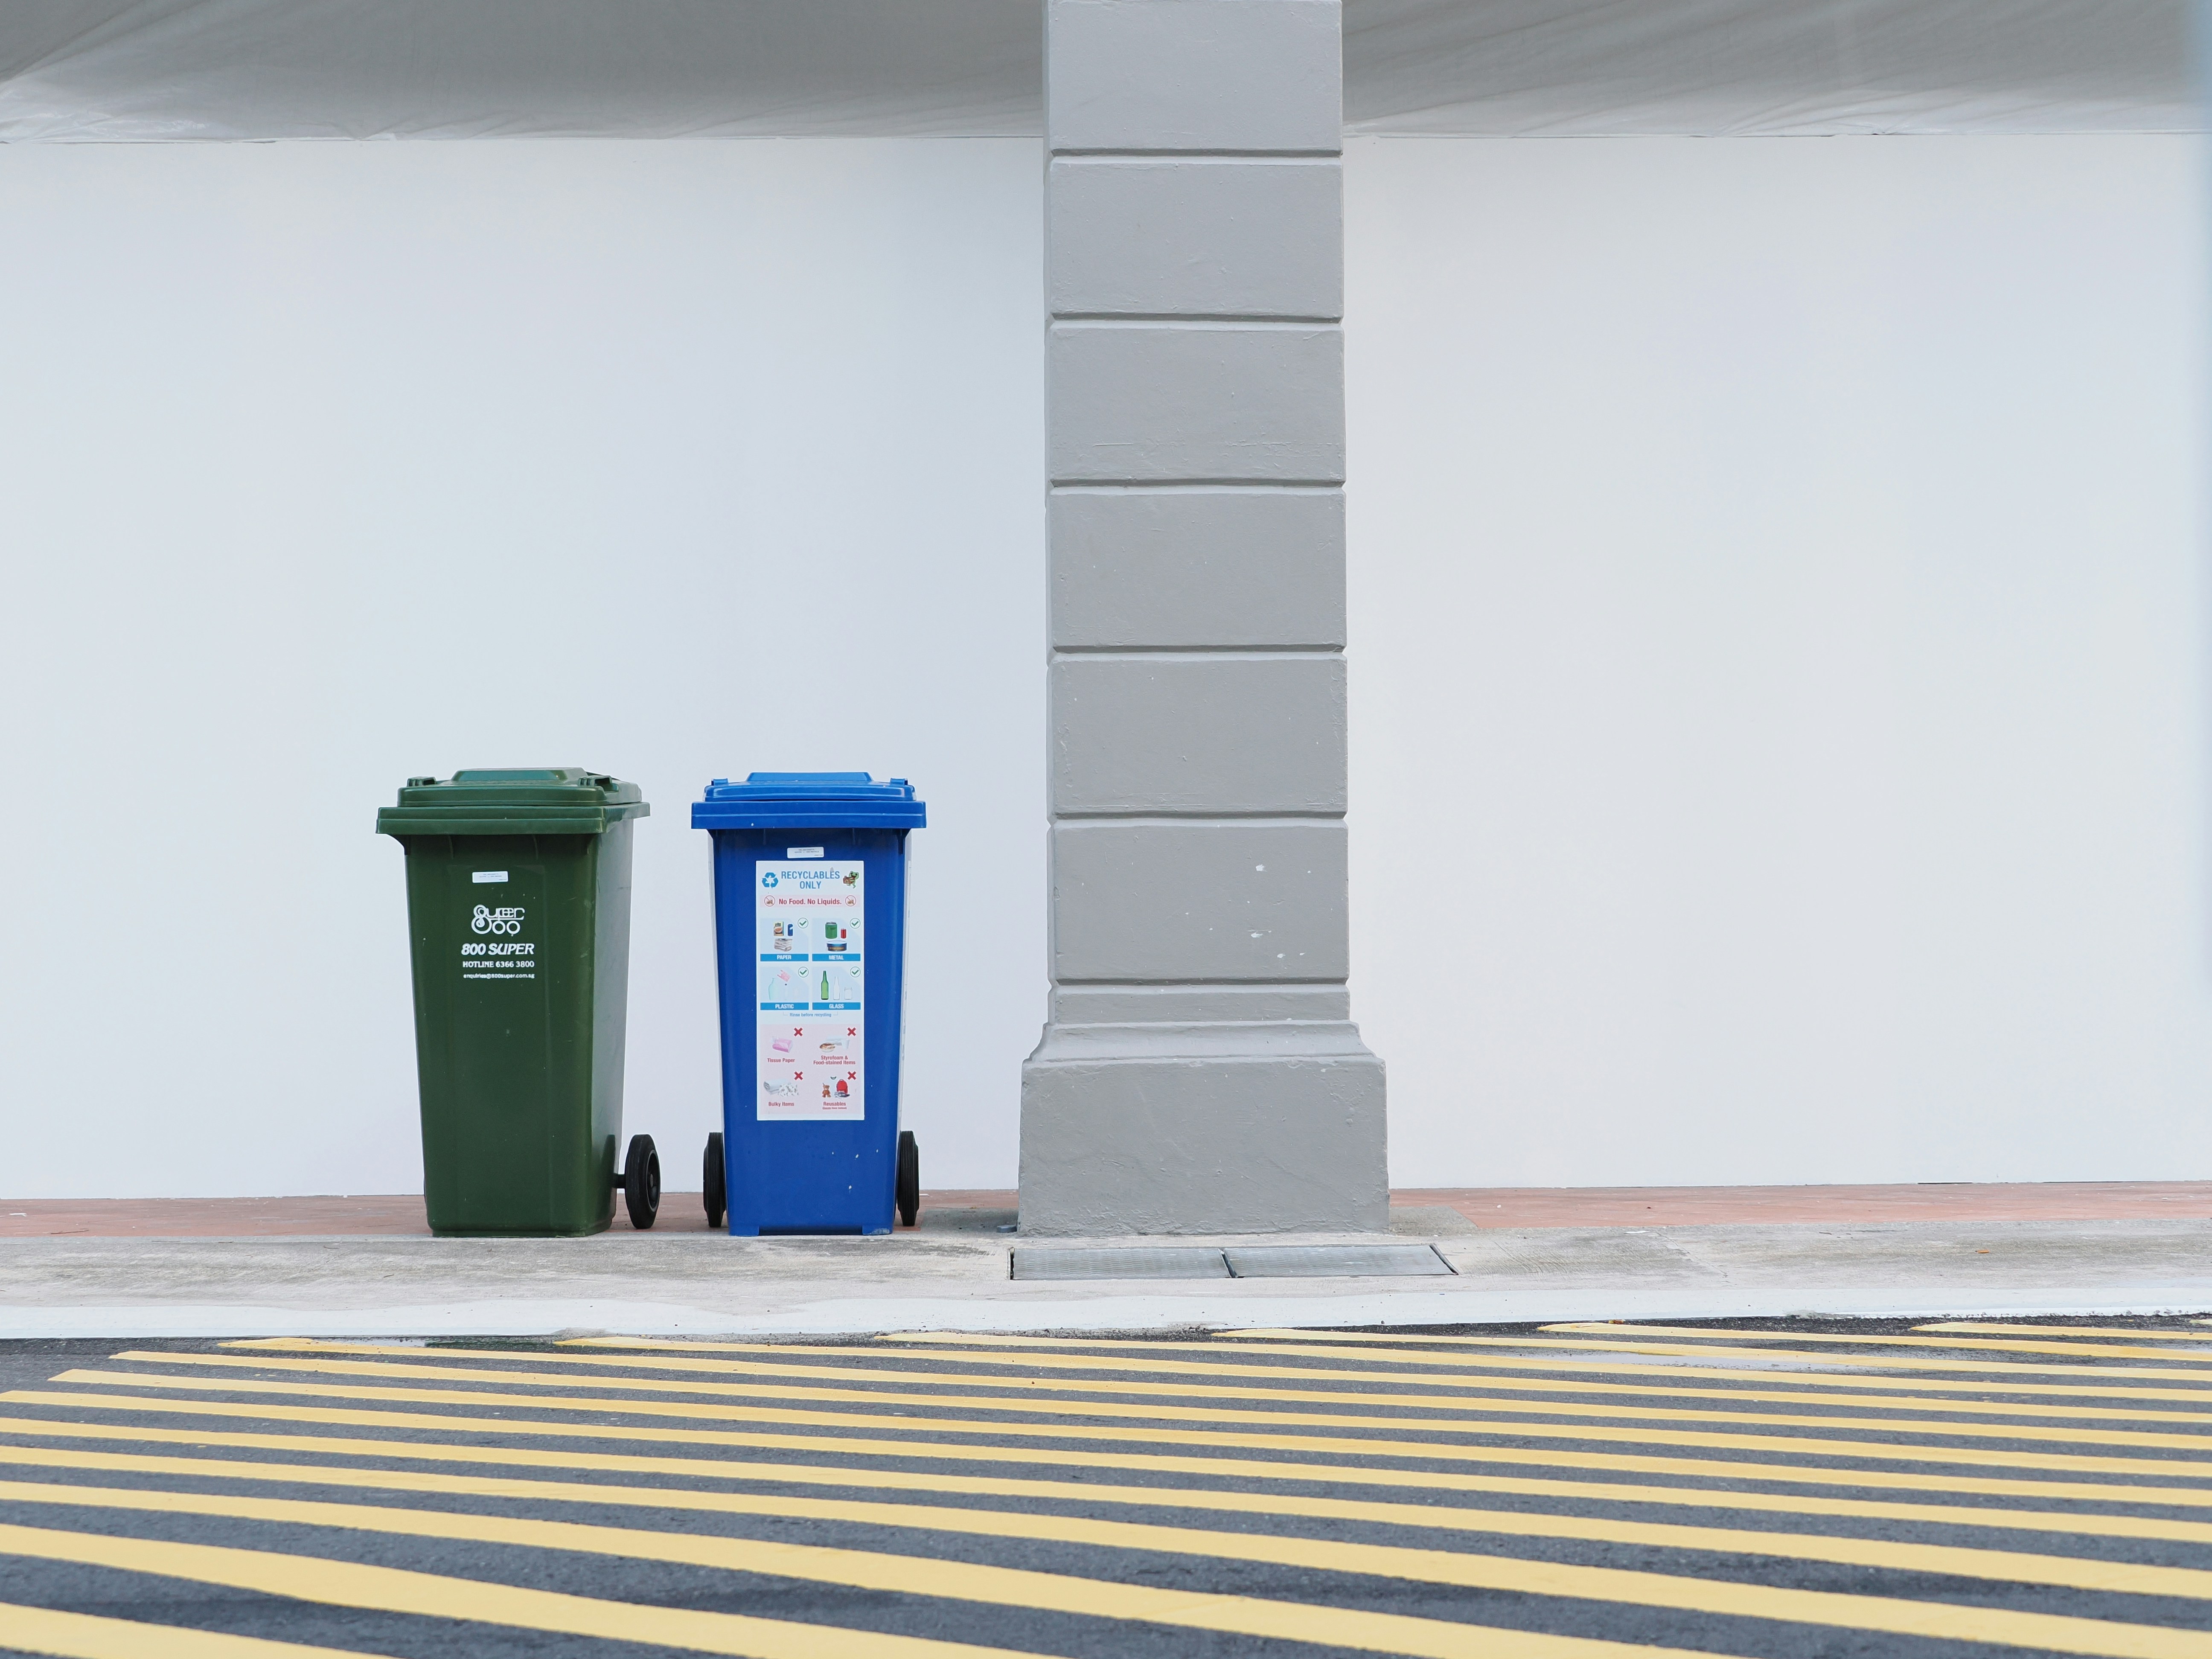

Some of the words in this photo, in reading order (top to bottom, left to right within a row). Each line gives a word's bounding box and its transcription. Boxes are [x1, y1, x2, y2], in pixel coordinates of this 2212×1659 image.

[781, 871, 840, 879] RECYCLABLES
[461, 943, 486, 955] 800
[488, 943, 534, 955] SUPER
